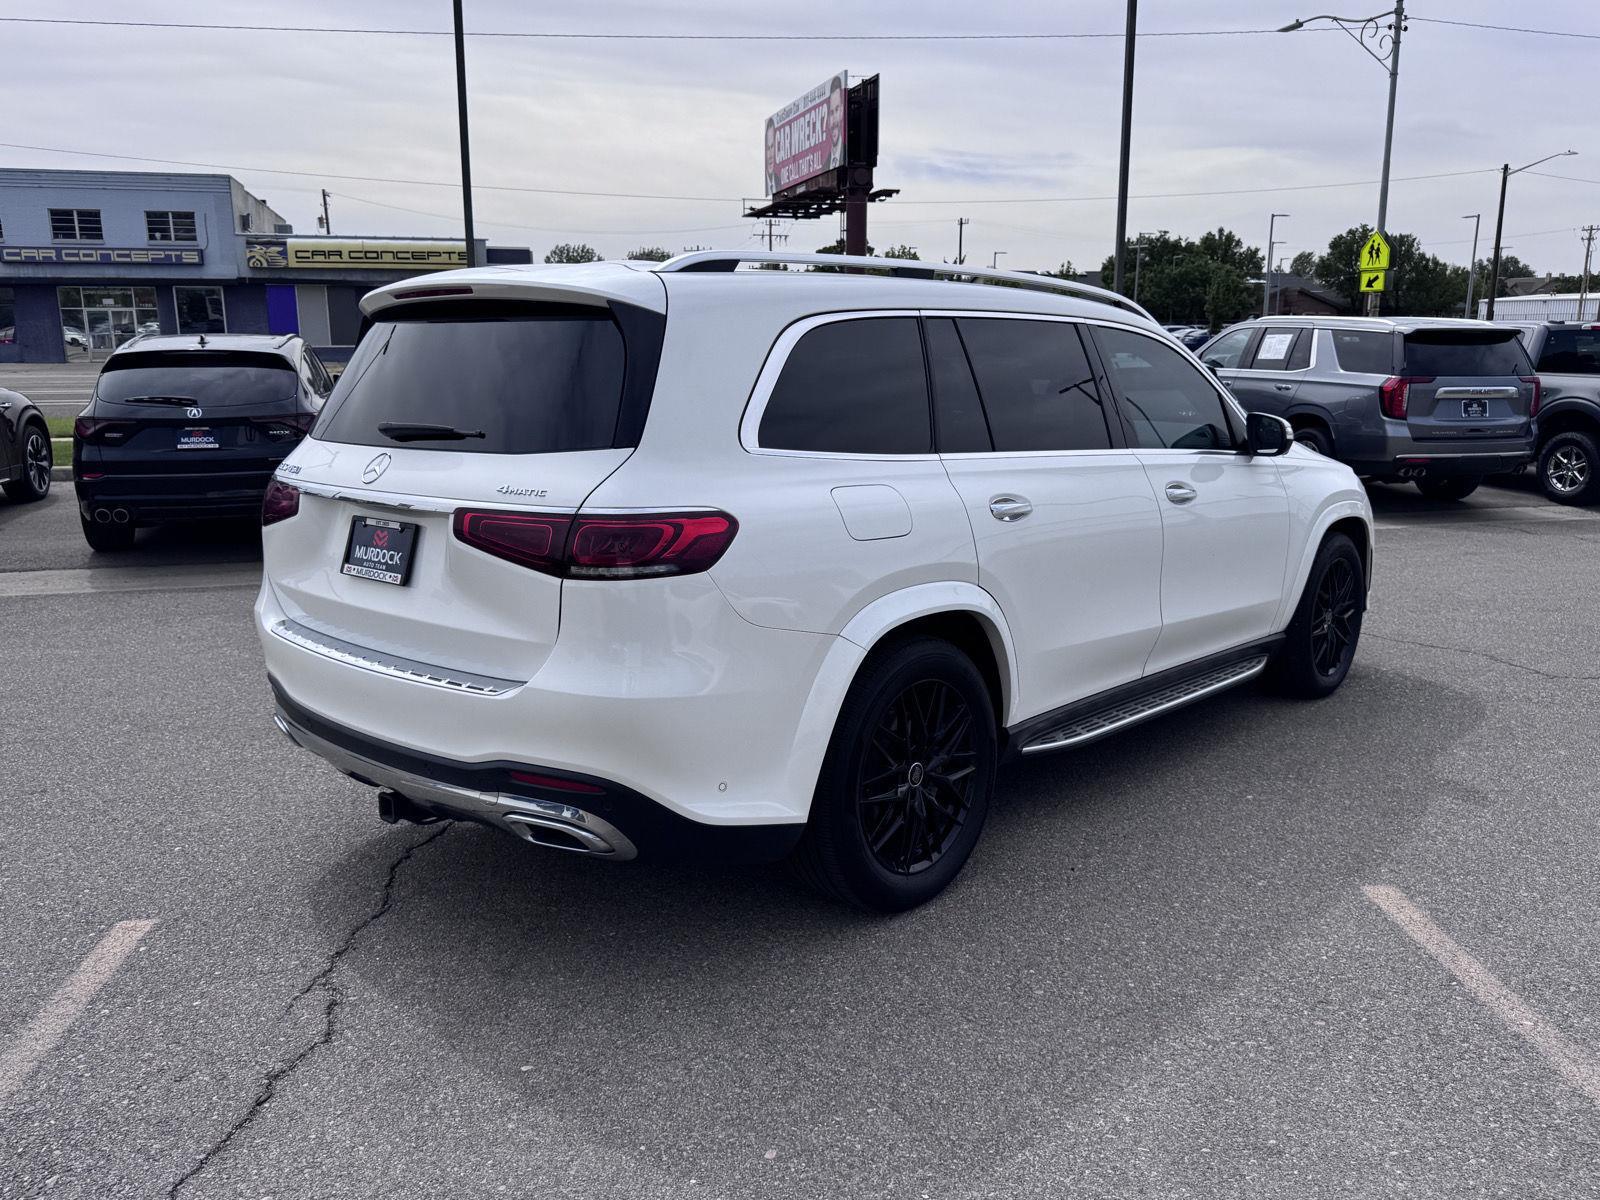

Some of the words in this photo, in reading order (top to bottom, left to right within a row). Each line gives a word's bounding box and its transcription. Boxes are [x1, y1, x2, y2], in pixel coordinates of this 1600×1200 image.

[775, 124, 791, 165] CAR
[791, 103, 828, 156] WRECK?
[3, 249, 57, 261] CAR
[61, 249, 199, 263] CONCEPTS
[294, 250, 343, 260] CAR
[496, 484, 548, 497] 4MATIC
[354, 544, 402, 565] MURDOCK
[355, 567, 387, 581] MURDOCK
